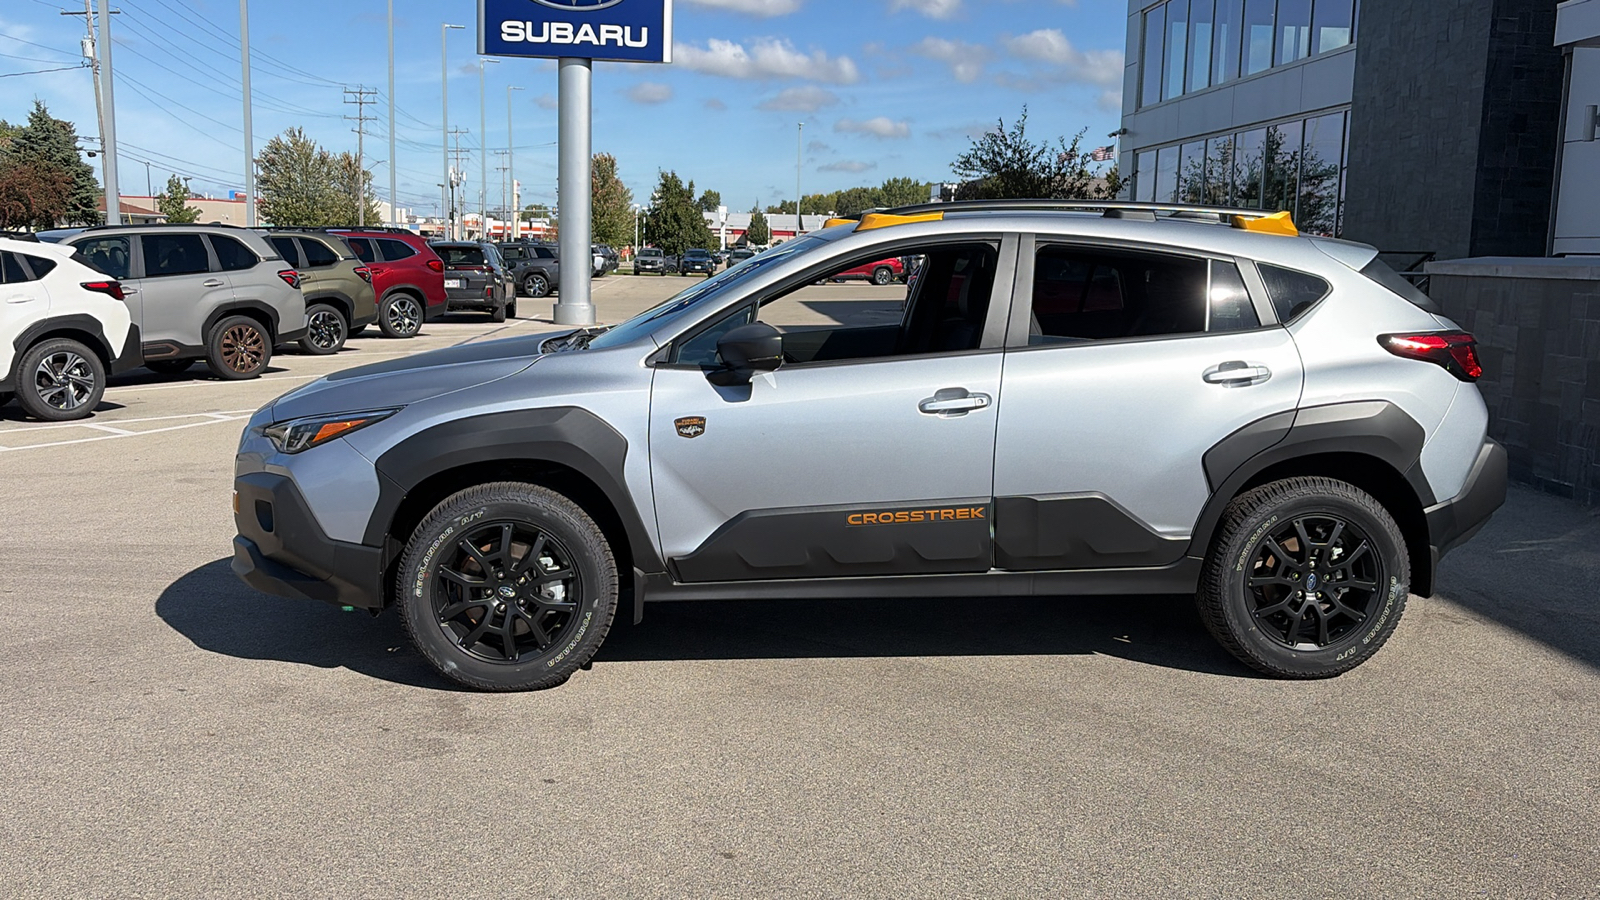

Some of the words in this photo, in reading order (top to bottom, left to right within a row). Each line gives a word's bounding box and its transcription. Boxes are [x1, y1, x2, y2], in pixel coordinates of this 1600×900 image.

[501, 20, 648, 48] SUBARU
[847, 507, 985, 525] CROSSTREK
[1236, 515, 1278, 572] YOKOHAMA
[415, 526, 454, 598] GEOLANDAR
[461, 510, 484, 526] A/T
[1362, 575, 1397, 645] GEOLANDAR
[546, 611, 592, 667] YOKOHAMA
[1336, 646, 1358, 661] A/T
